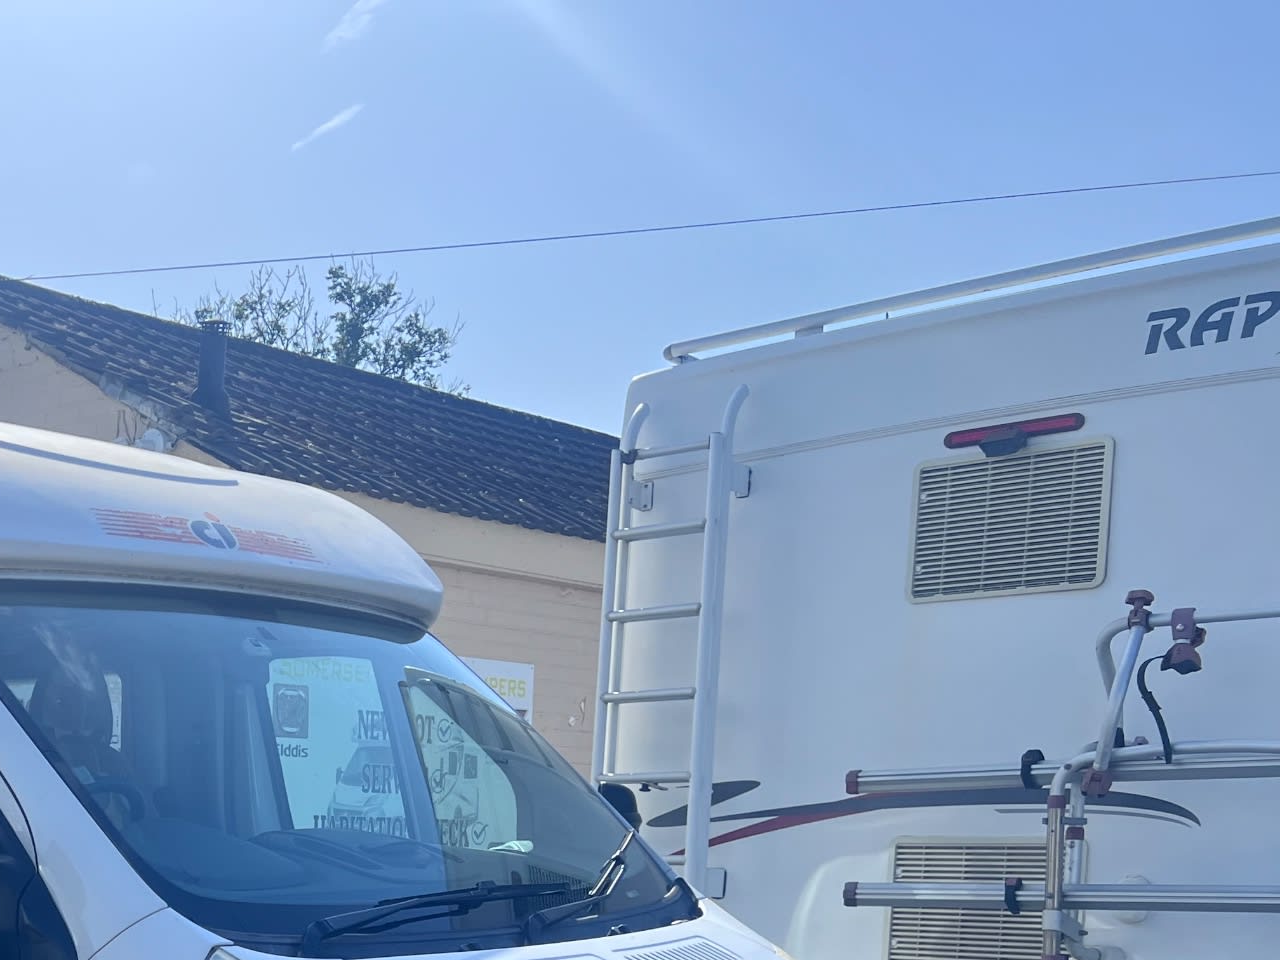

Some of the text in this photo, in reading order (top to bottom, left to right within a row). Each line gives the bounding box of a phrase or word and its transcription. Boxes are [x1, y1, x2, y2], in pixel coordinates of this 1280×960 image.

[1145, 291, 1280, 355] RAP
[279, 659, 527, 698] SOMERSE PERS
[414, 713, 435, 745] OT
[439, 818, 470, 848] ECK
